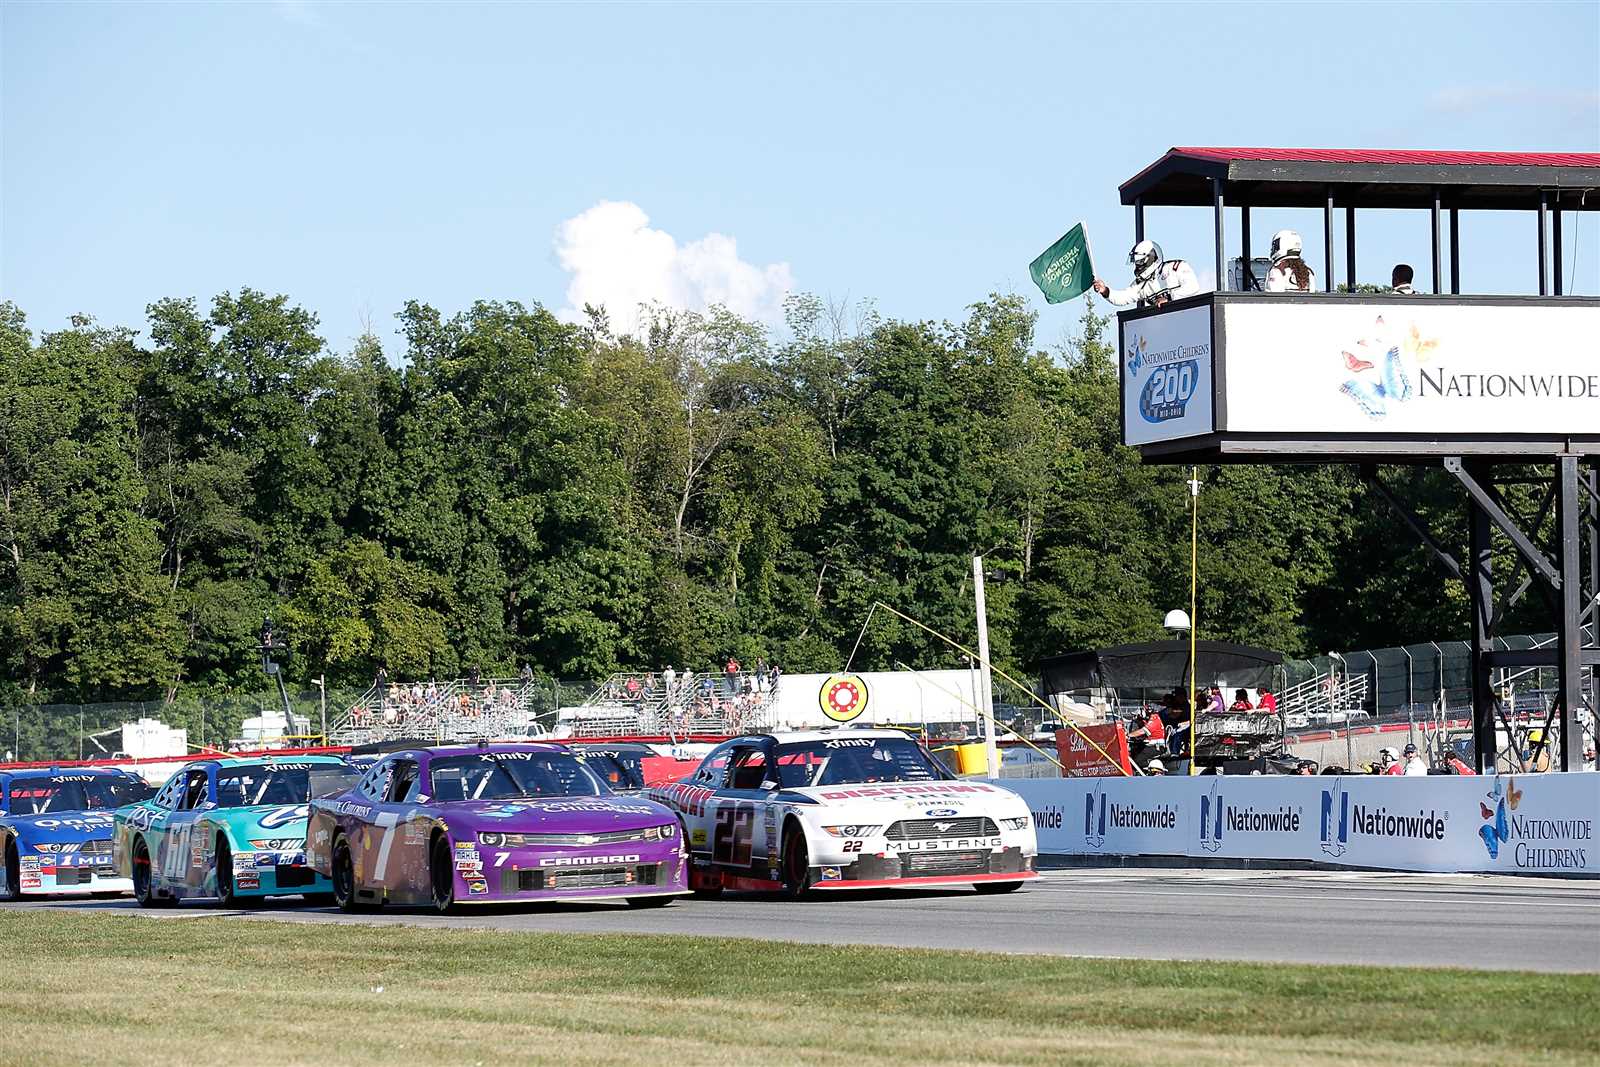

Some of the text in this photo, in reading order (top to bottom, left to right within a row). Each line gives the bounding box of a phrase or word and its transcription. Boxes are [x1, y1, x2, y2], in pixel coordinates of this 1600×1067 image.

[1142, 349, 1177, 366] NATIONWIDE
[1151, 365, 1192, 406] 200
[1419, 367, 1599, 397] NATIONWIDE
[823, 738, 876, 749] xfinity
[576, 750, 620, 759] finity
[50, 775, 95, 783] xfinity
[820, 785, 995, 800] DISCOUNT
[1110, 803, 1176, 829] Nationwide
[1227, 806, 1299, 832] Nationwide
[1353, 804, 1445, 840] Nationwide
[712, 800, 754, 868] 22
[1511, 814, 1592, 840] NATIONWIDE
[373, 812, 400, 881] 7
[842, 840, 863, 852] 22
[886, 838, 1002, 851] MUSTANG
[60, 856, 73, 866] 1
[494, 852, 511, 867] 7
[539, 854, 640, 866] CAMARO
[1515, 842, 1586, 869] CHILDREN'S
